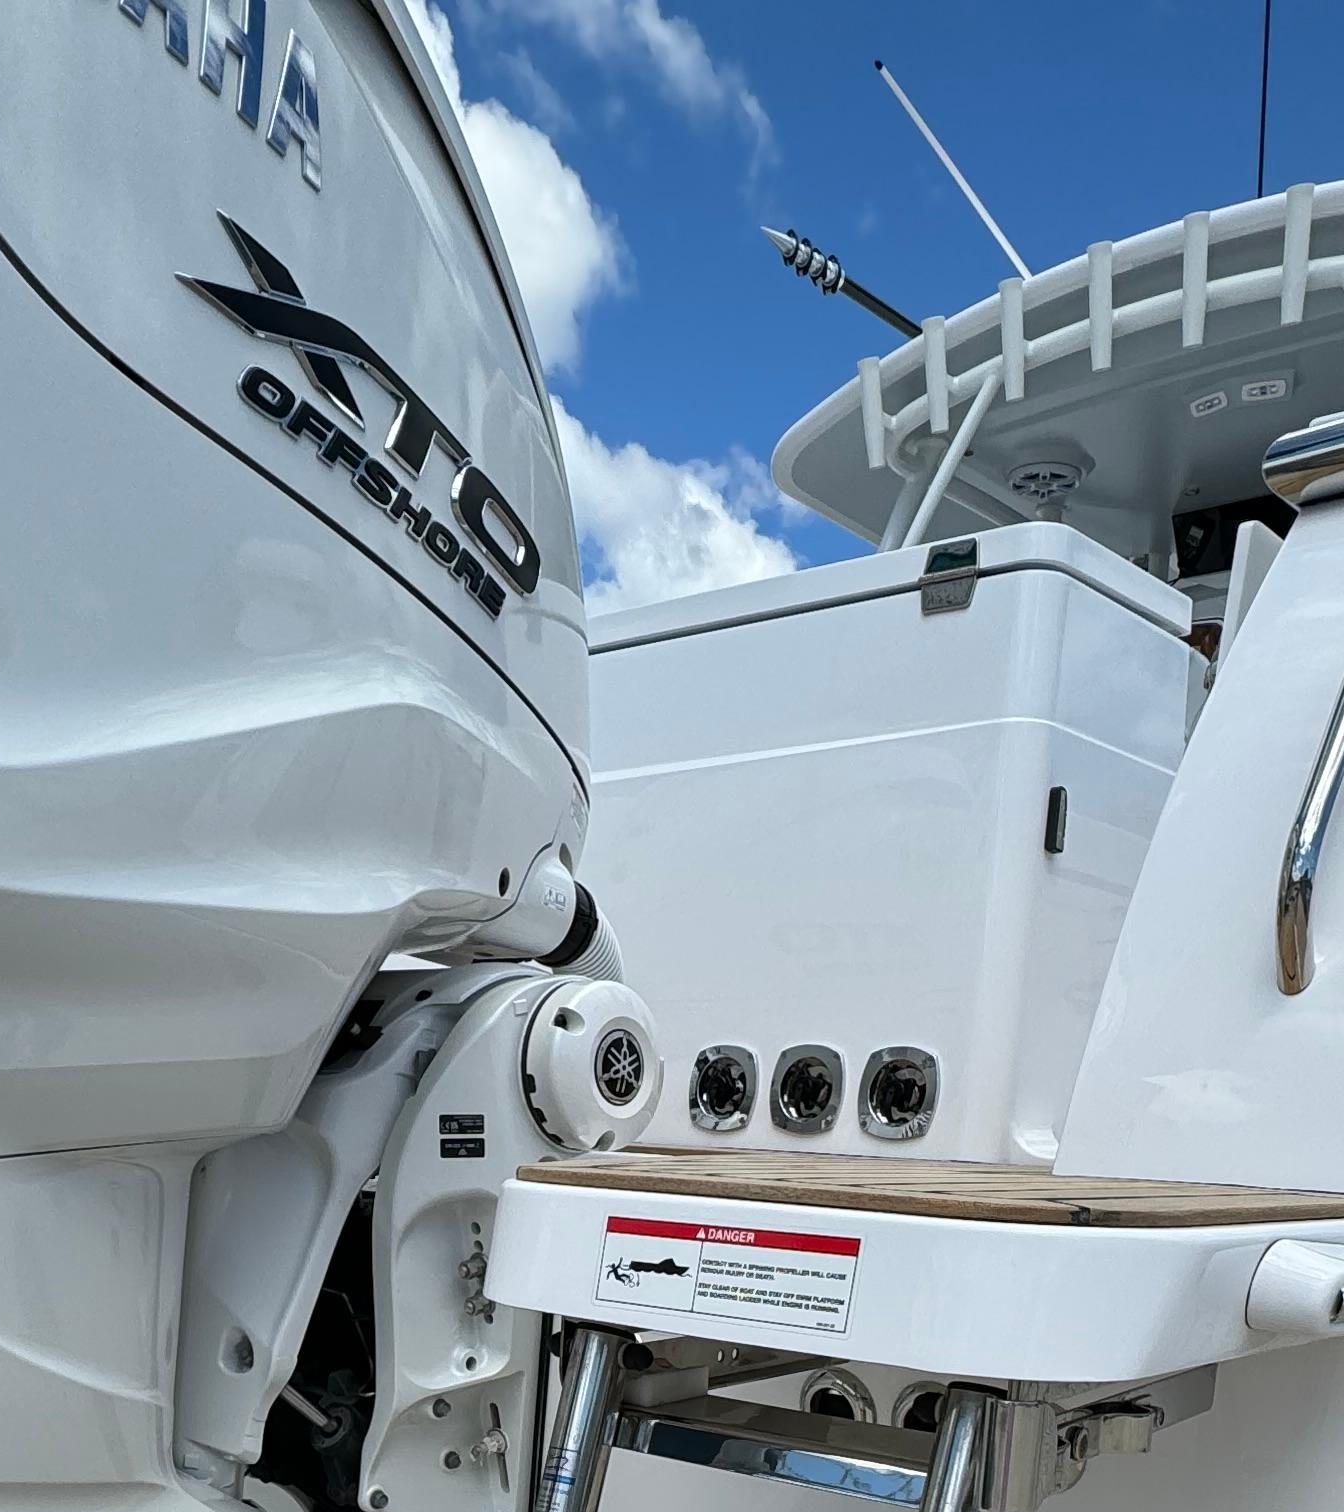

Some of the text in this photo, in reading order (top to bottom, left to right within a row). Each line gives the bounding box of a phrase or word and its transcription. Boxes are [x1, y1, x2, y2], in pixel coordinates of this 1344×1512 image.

[174, 208, 542, 598] XTO
[236, 363, 507, 620] OFFSHORE
[707, 1228, 755, 1243] DANGER
[776, 1267, 810, 1277] PROPELLER
[811, 1270, 825, 1279] WILL
[697, 1290, 709, 1298] AND
[712, 1283, 730, 1292] CLEAR
[731, 1285, 738, 1293] OF
[755, 1289, 768, 1297] AND
[768, 1290, 782, 1298] STAY
[783, 1292, 794, 1300] OFF
[813, 1295, 845, 1306] PLATFORM
